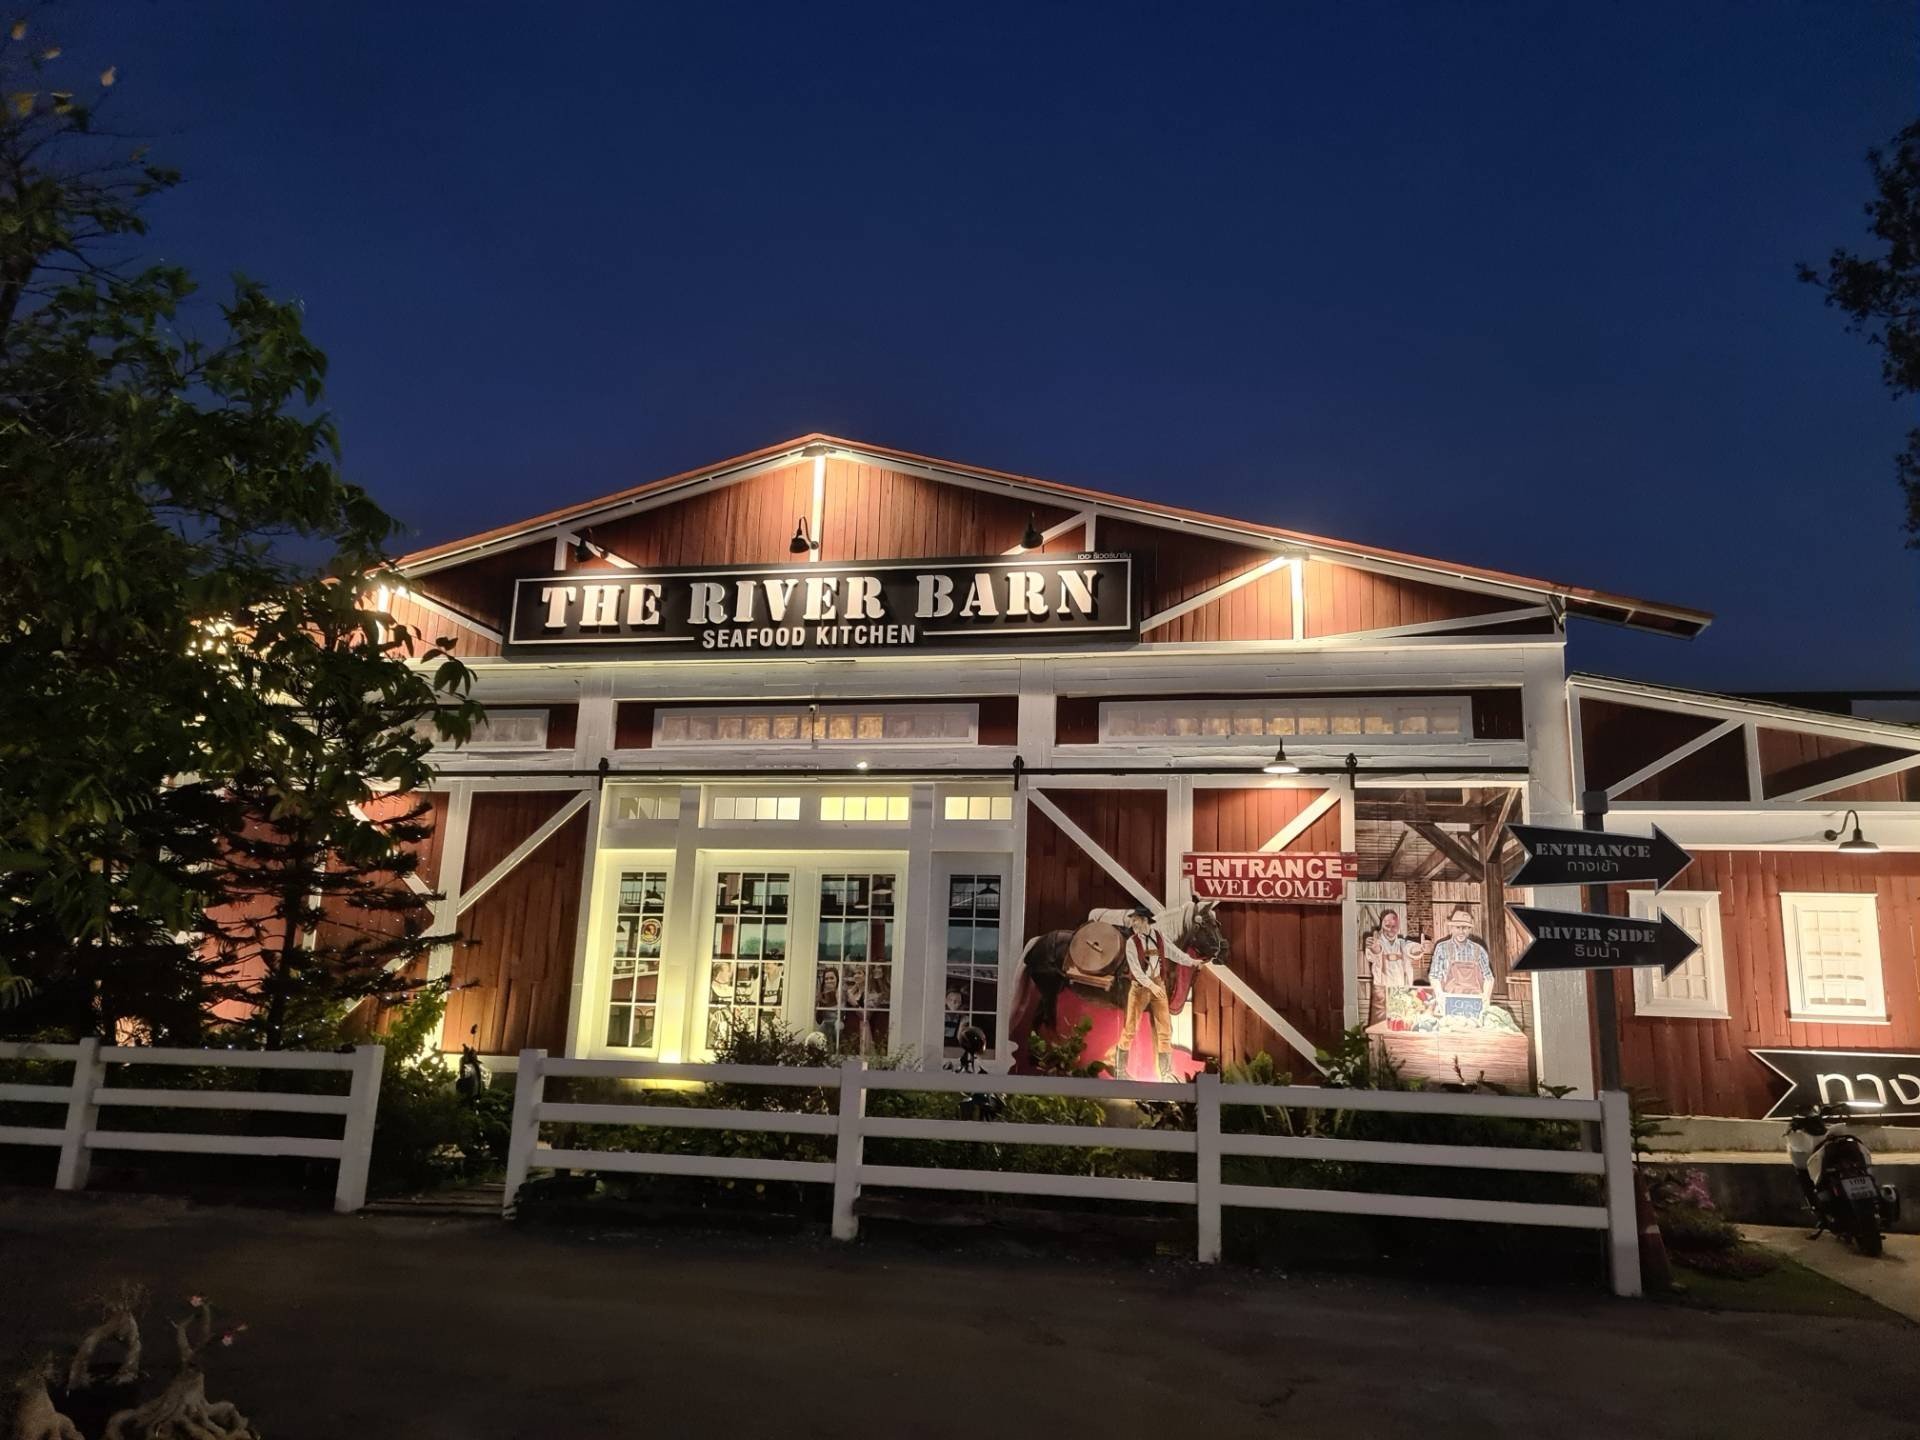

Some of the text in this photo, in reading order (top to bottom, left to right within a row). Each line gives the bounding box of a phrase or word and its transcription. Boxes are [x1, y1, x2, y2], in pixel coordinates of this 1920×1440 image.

[541, 569, 1097, 628] THE RIVER BARN
[702, 624, 915, 649] SEAFOOD KITCHEN
[1535, 843, 1651, 858] ENTRANCE
[1196, 858, 1342, 879] ENTRANCE
[1567, 859, 1619, 873] ทางเข้า
[1203, 879, 1334, 899] WELCOME
[1538, 926, 1656, 943] RIVER SIDE
[1575, 942, 1621, 959] ริมน้ำ
